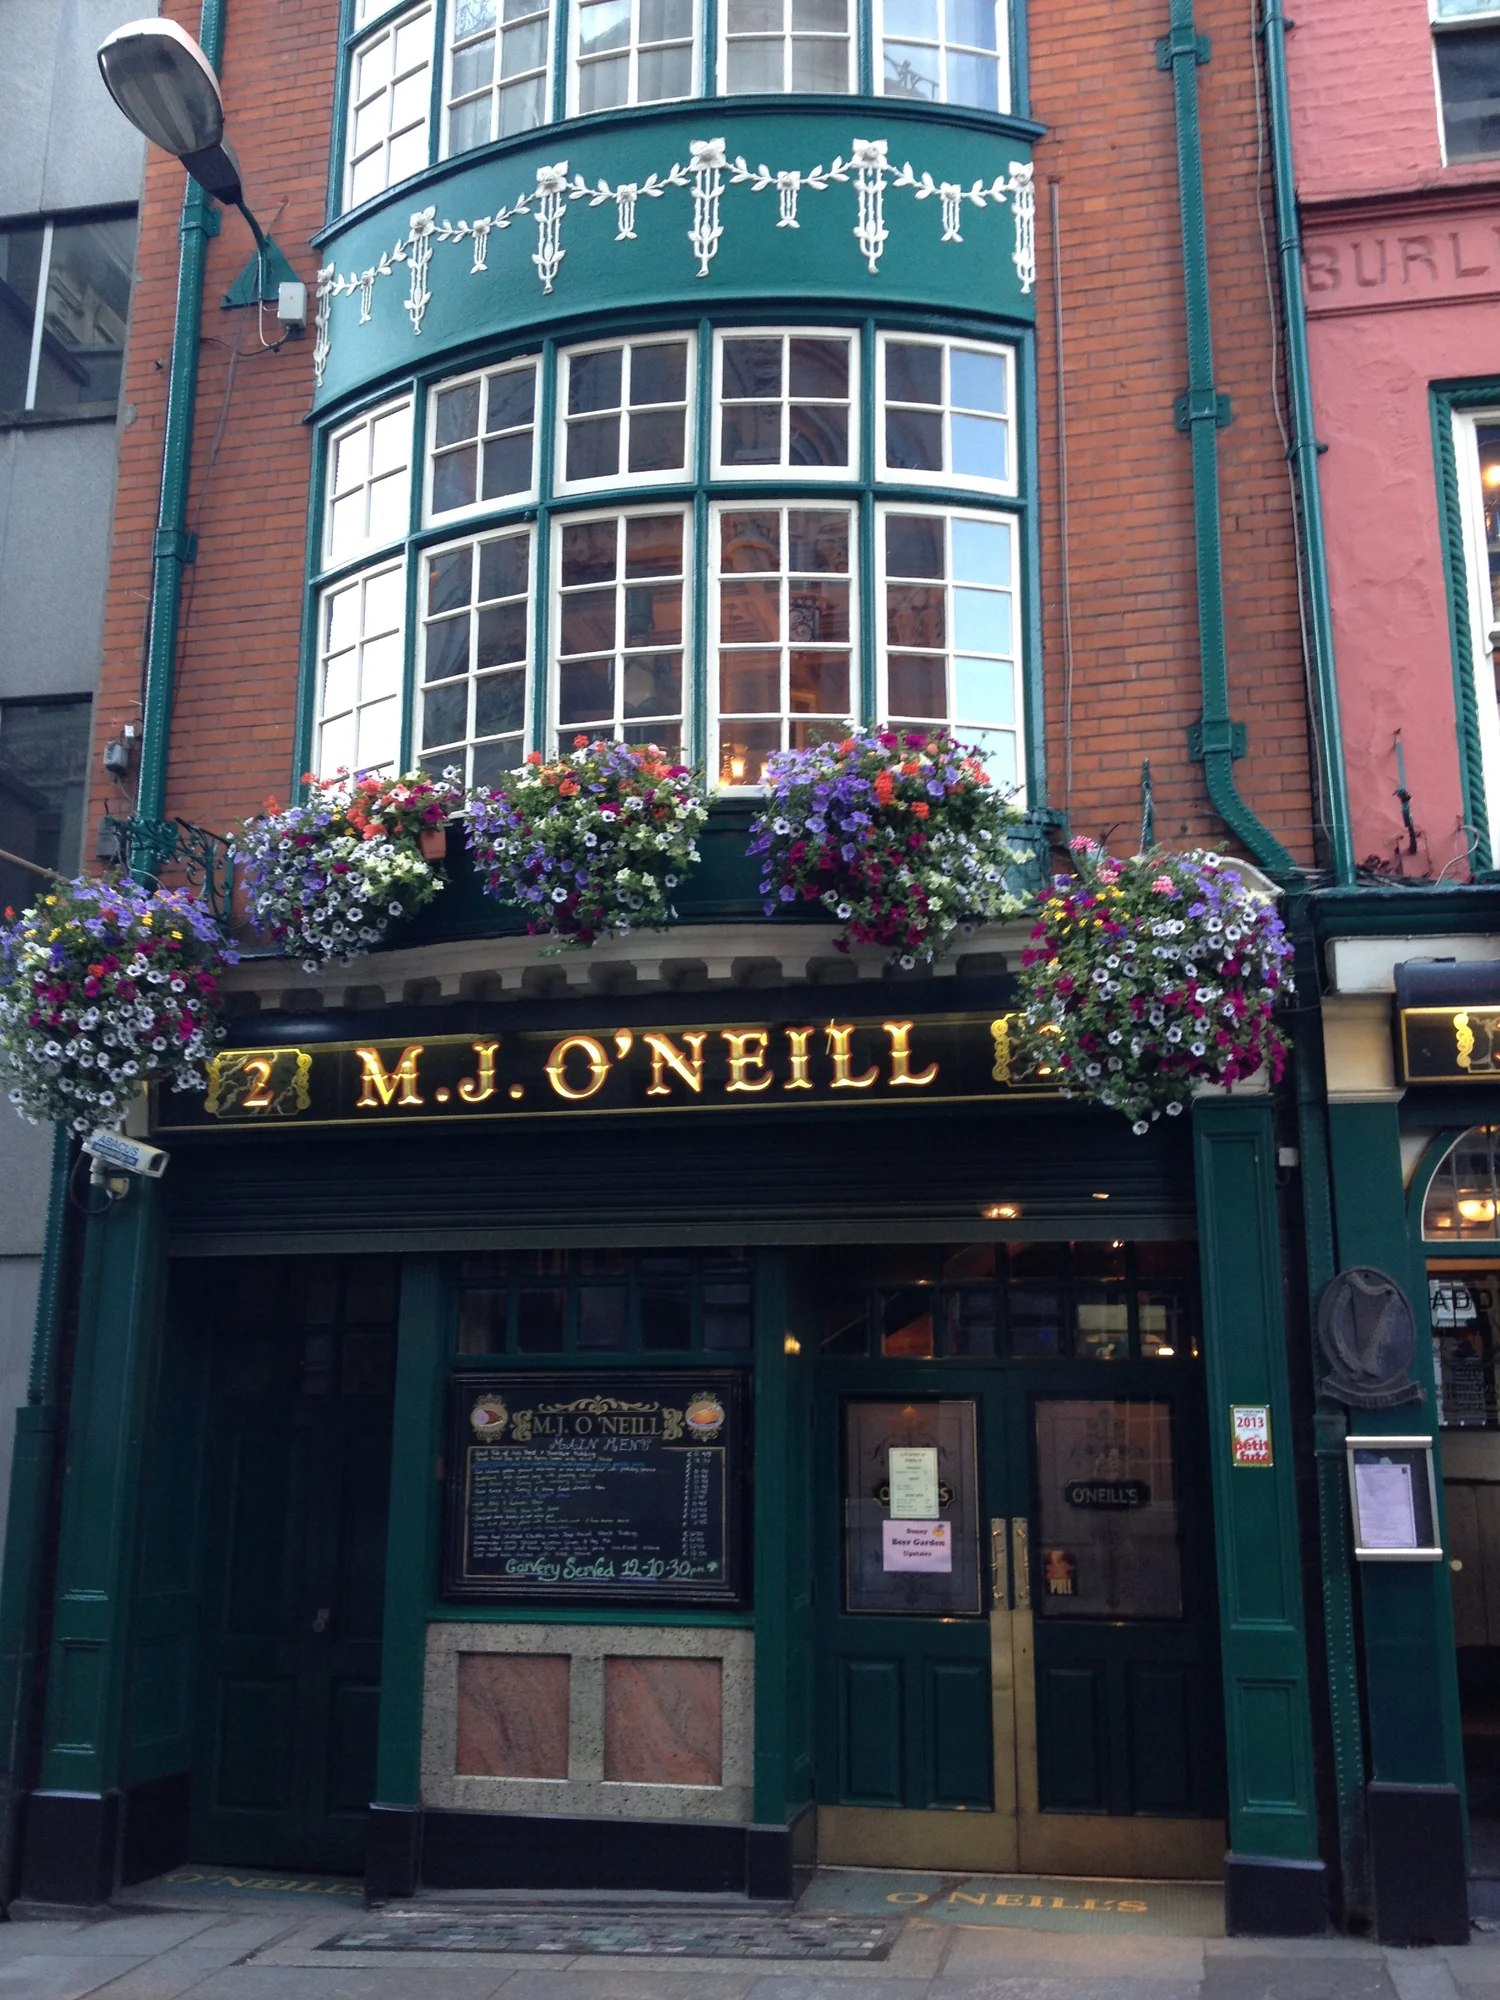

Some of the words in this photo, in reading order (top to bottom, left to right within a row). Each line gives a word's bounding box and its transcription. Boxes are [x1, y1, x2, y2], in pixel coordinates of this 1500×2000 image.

[1303, 226, 1500, 292] BURL
[241, 1057, 275, 1107] 2
[355, 1041, 525, 1108] M.J.
[543, 1020, 939, 1099] O'NEILL
[98, 1134, 140, 1157] ABACUS
[1237, 1416, 1264, 1428] 2013
[891, 1538, 912, 1546] Beer
[913, 1538, 945, 1547] Garden
